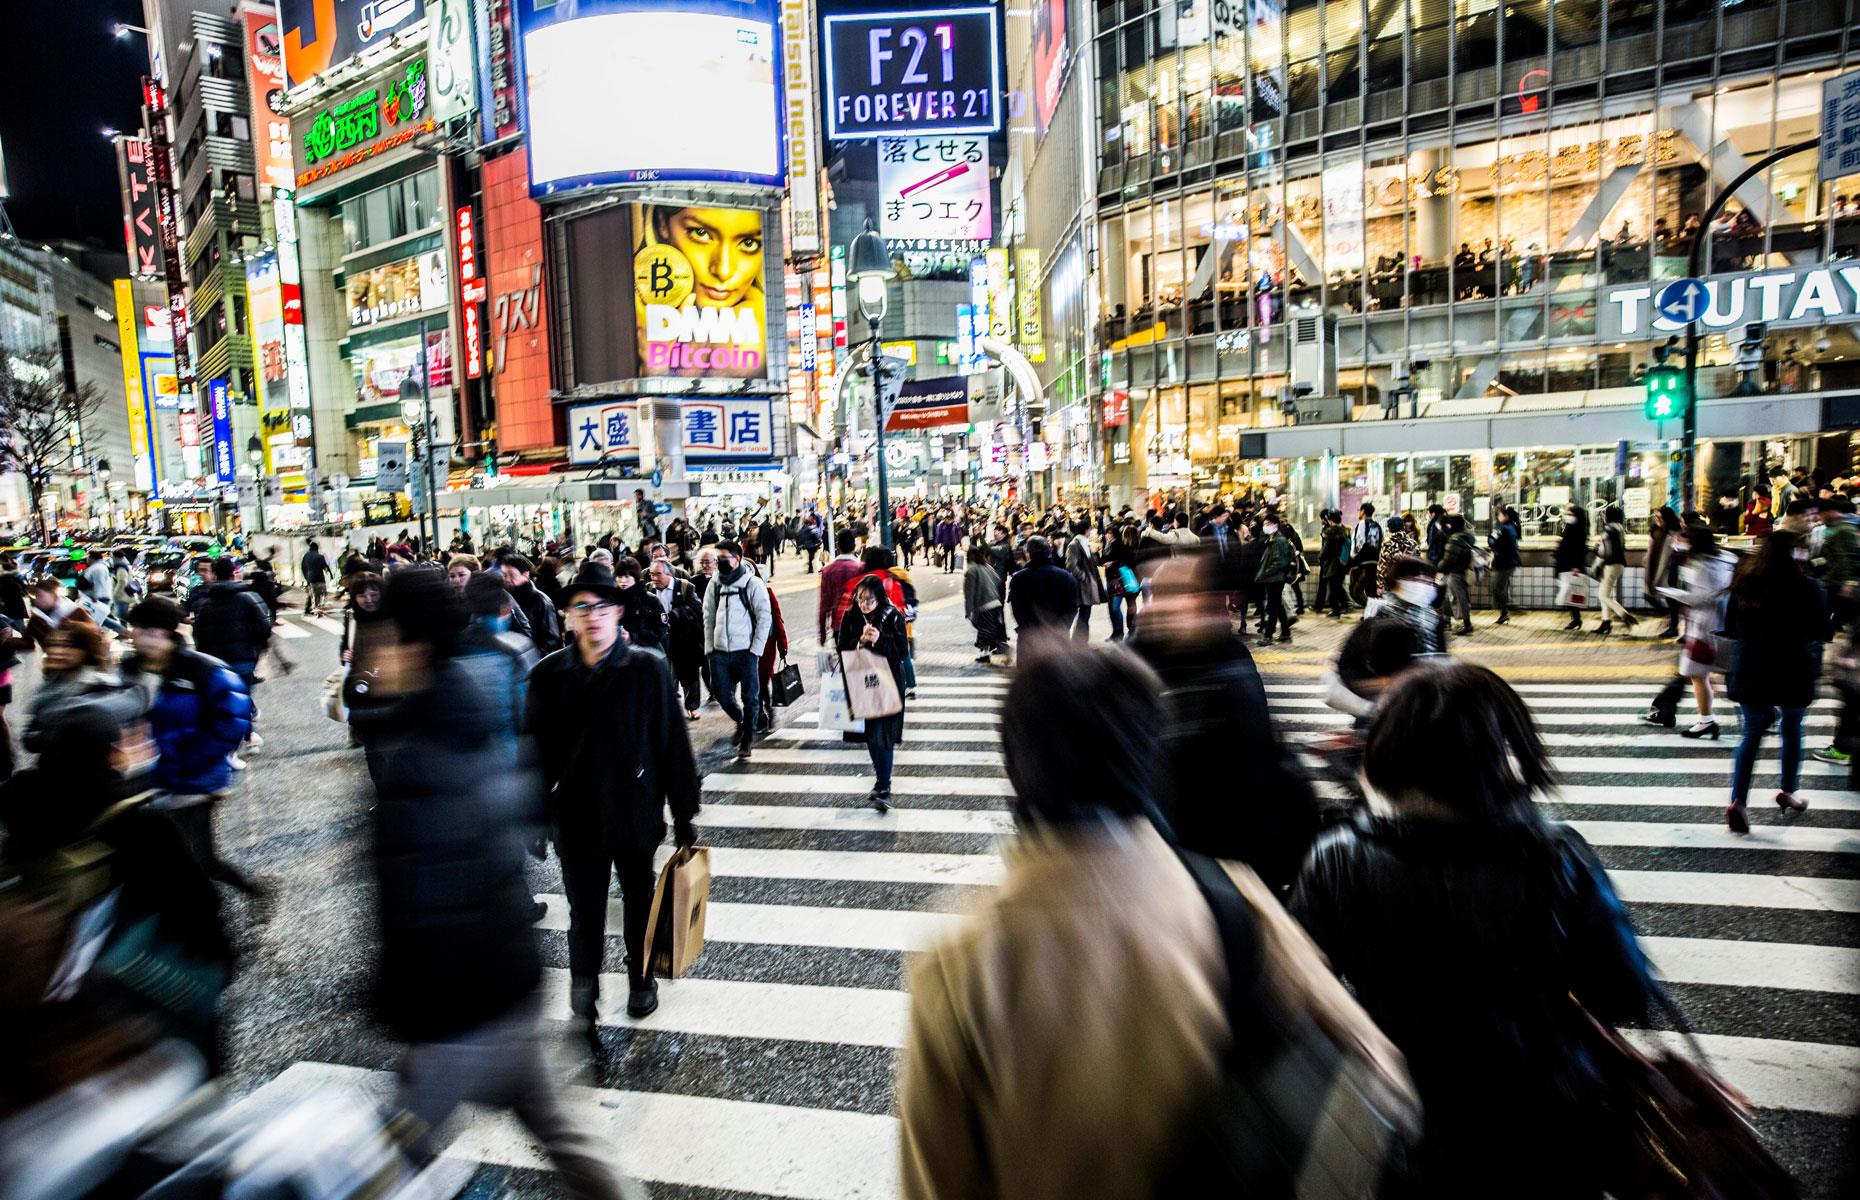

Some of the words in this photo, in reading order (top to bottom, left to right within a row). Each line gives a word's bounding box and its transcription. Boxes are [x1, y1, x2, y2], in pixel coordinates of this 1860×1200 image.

[868, 23, 954, 86] F21
[837, 90, 957, 124] FOREVER
[962, 88, 989, 118] 21
[790, 99, 807, 178] neon
[882, 137, 983, 163] 落とせる
[1488, 127, 1677, 185] COFFEE
[636, 170, 660, 181] DHC
[886, 199, 984, 222] まつエク
[351, 294, 422, 326] Euphoria
[645, 303, 760, 343] DMM
[647, 342, 760, 370] Bitcoin
